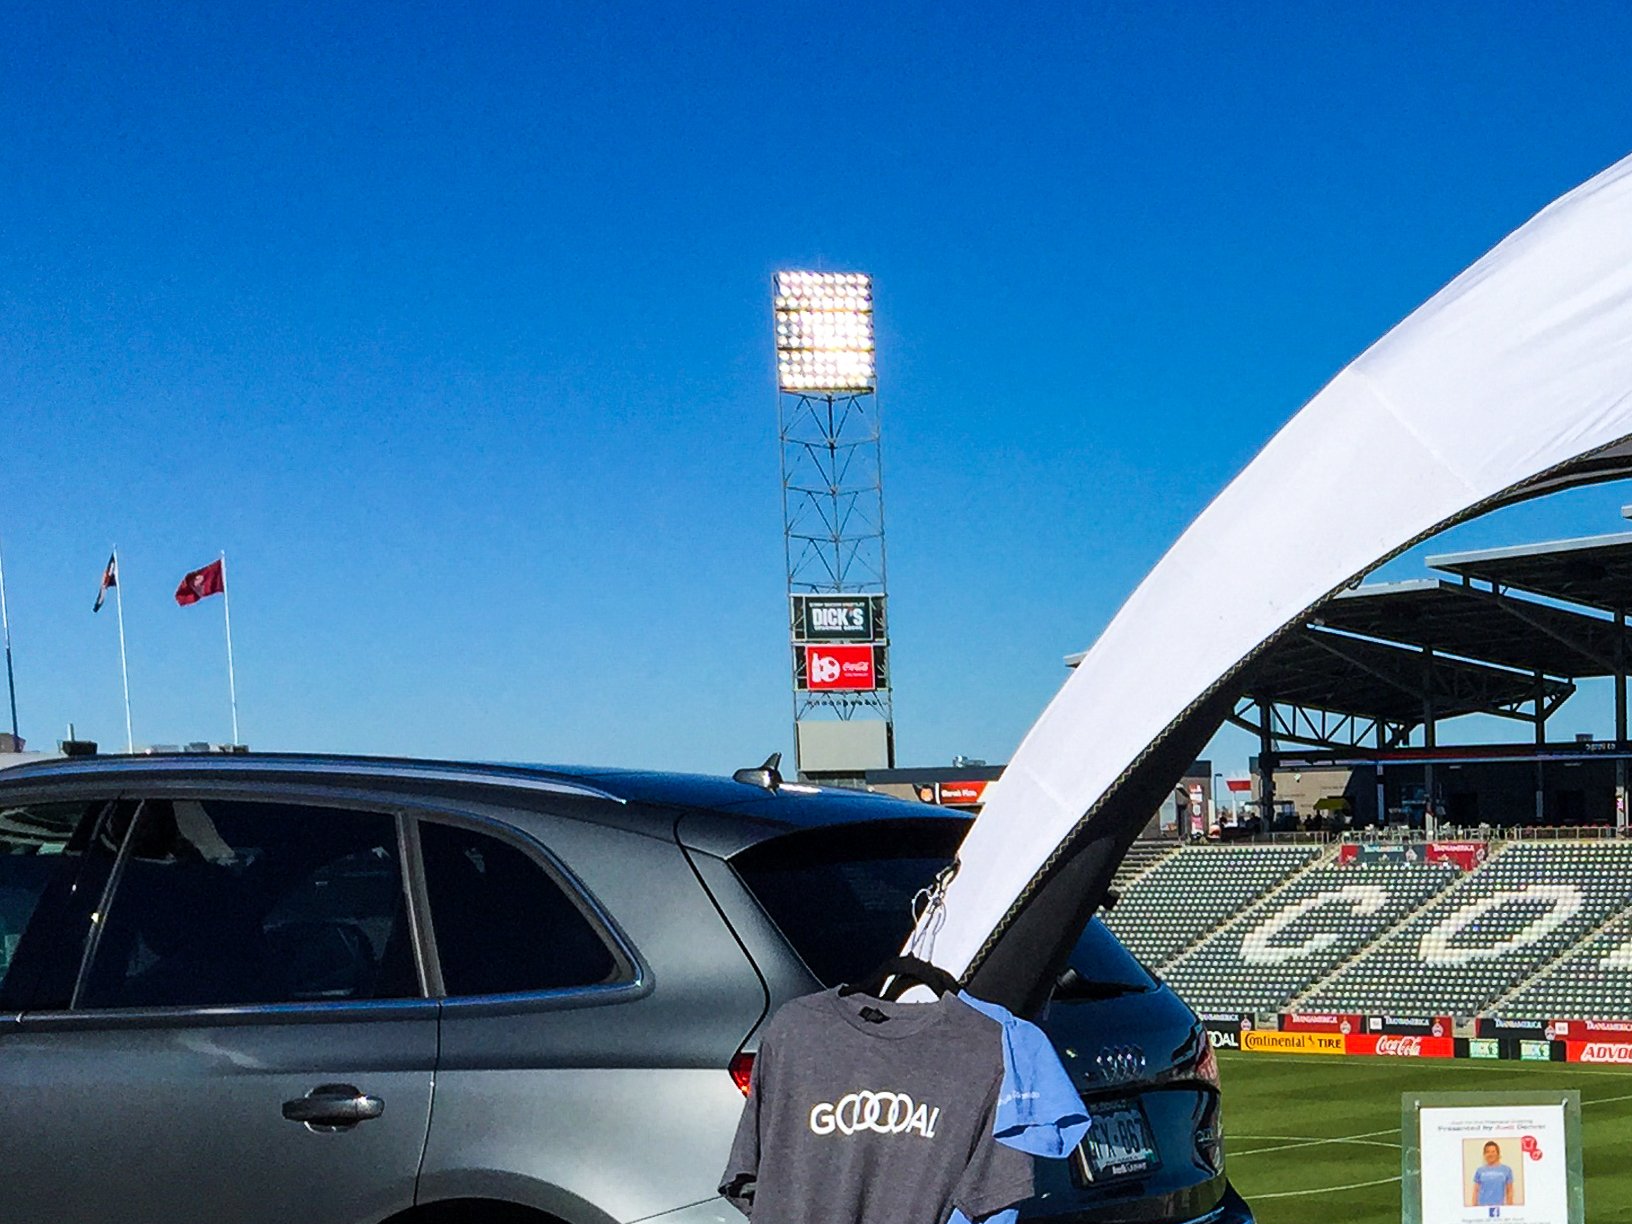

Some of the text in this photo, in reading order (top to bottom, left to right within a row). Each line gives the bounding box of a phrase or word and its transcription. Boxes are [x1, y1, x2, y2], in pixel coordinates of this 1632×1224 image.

[811, 607, 865, 626] DICK'S
[1244, 1032, 1342, 1050] Continental TIRE
